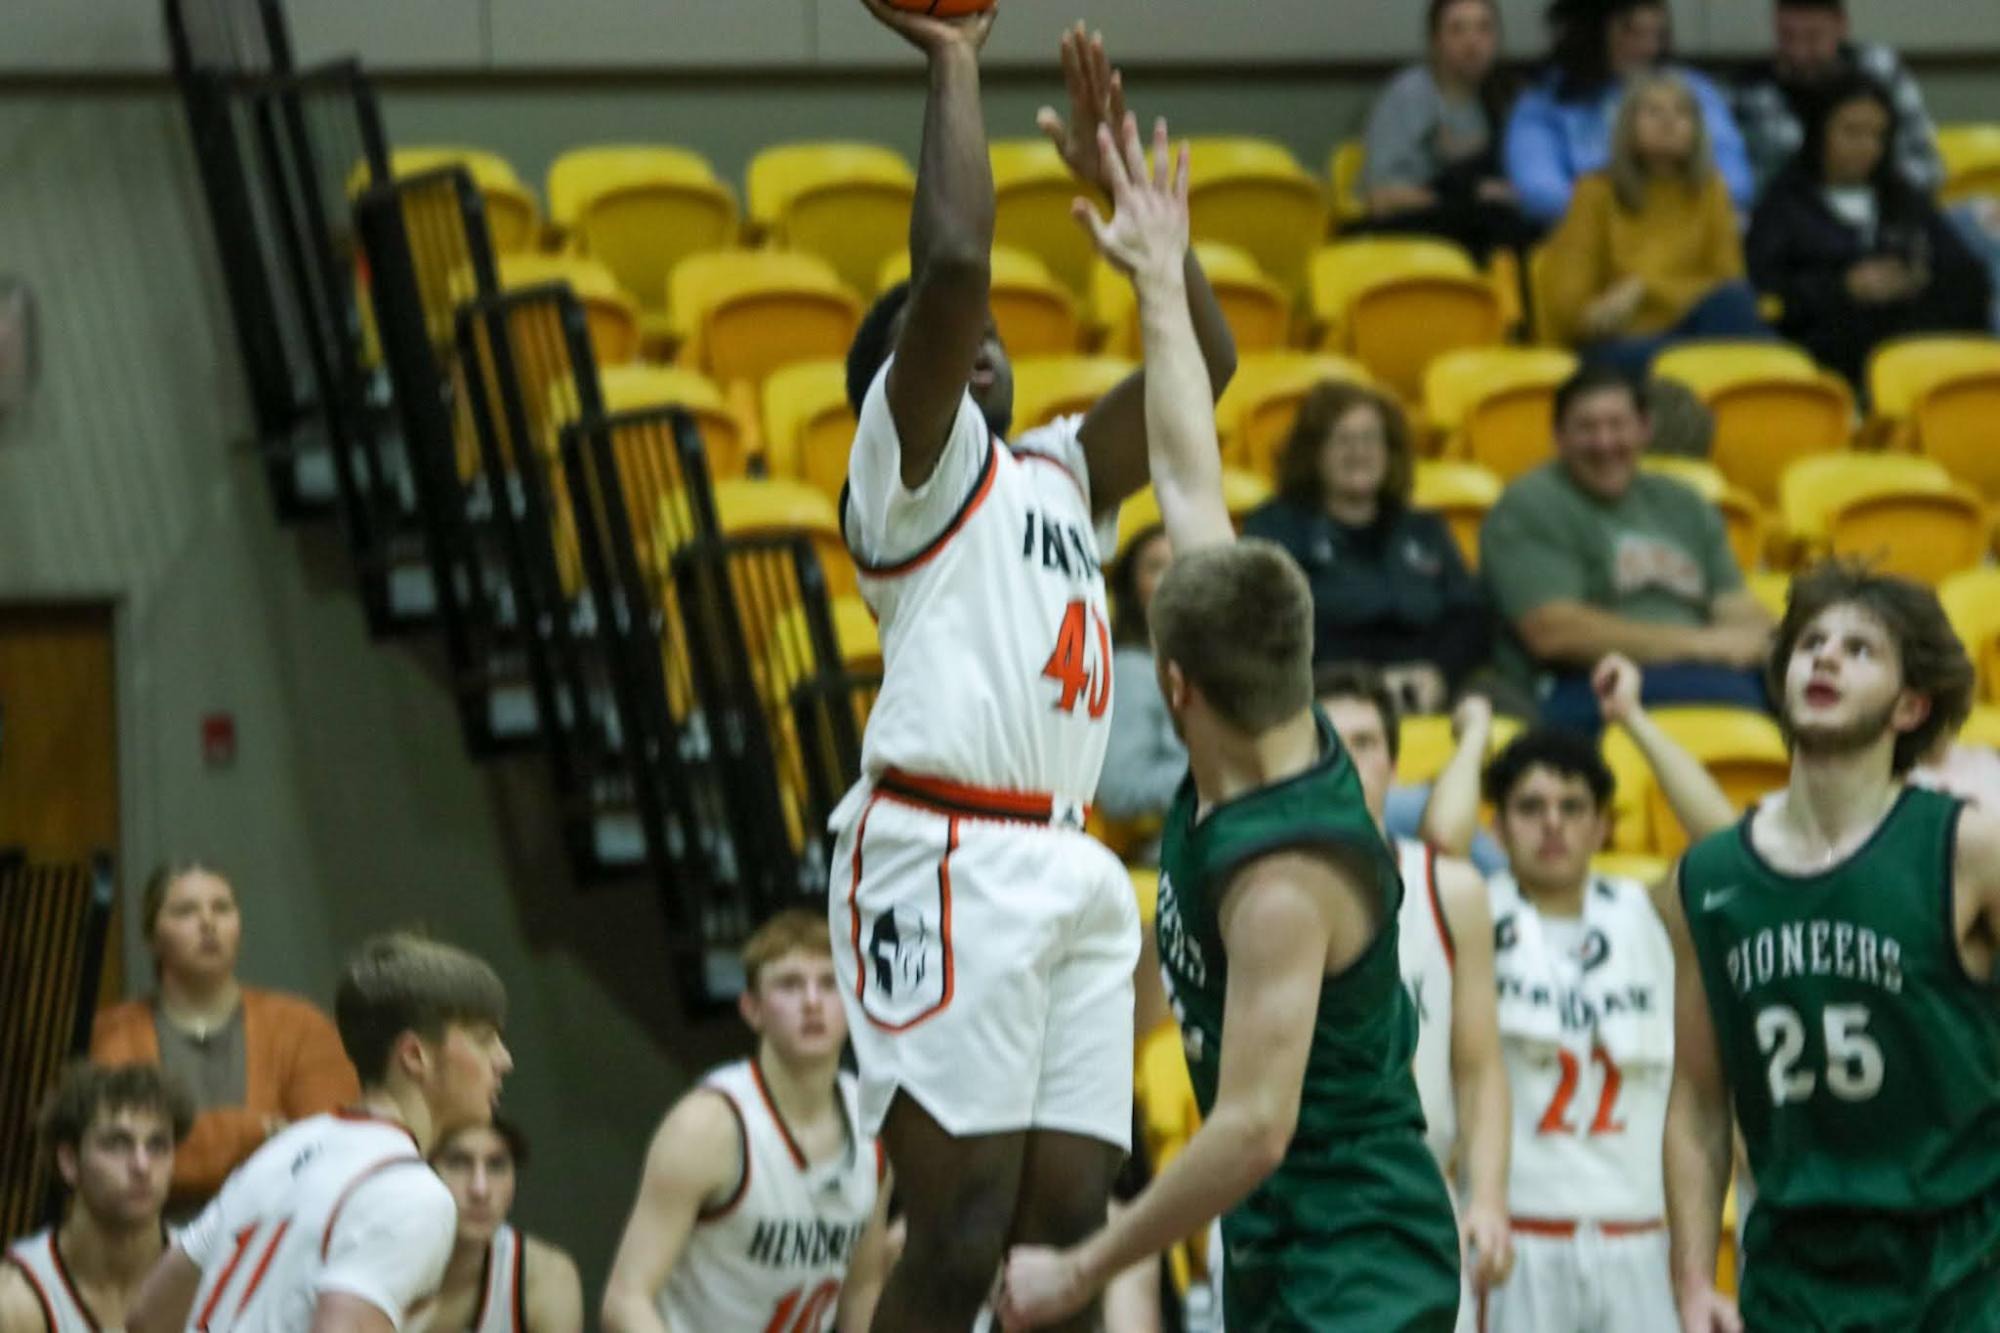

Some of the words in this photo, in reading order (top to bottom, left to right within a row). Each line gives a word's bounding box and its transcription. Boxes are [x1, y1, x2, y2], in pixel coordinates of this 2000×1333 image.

[1727, 919, 1903, 996] PIONEERS
[1534, 1044, 1626, 1137] 22
[1756, 1002, 1885, 1108] 25
[196, 1216, 294, 1332] 11
